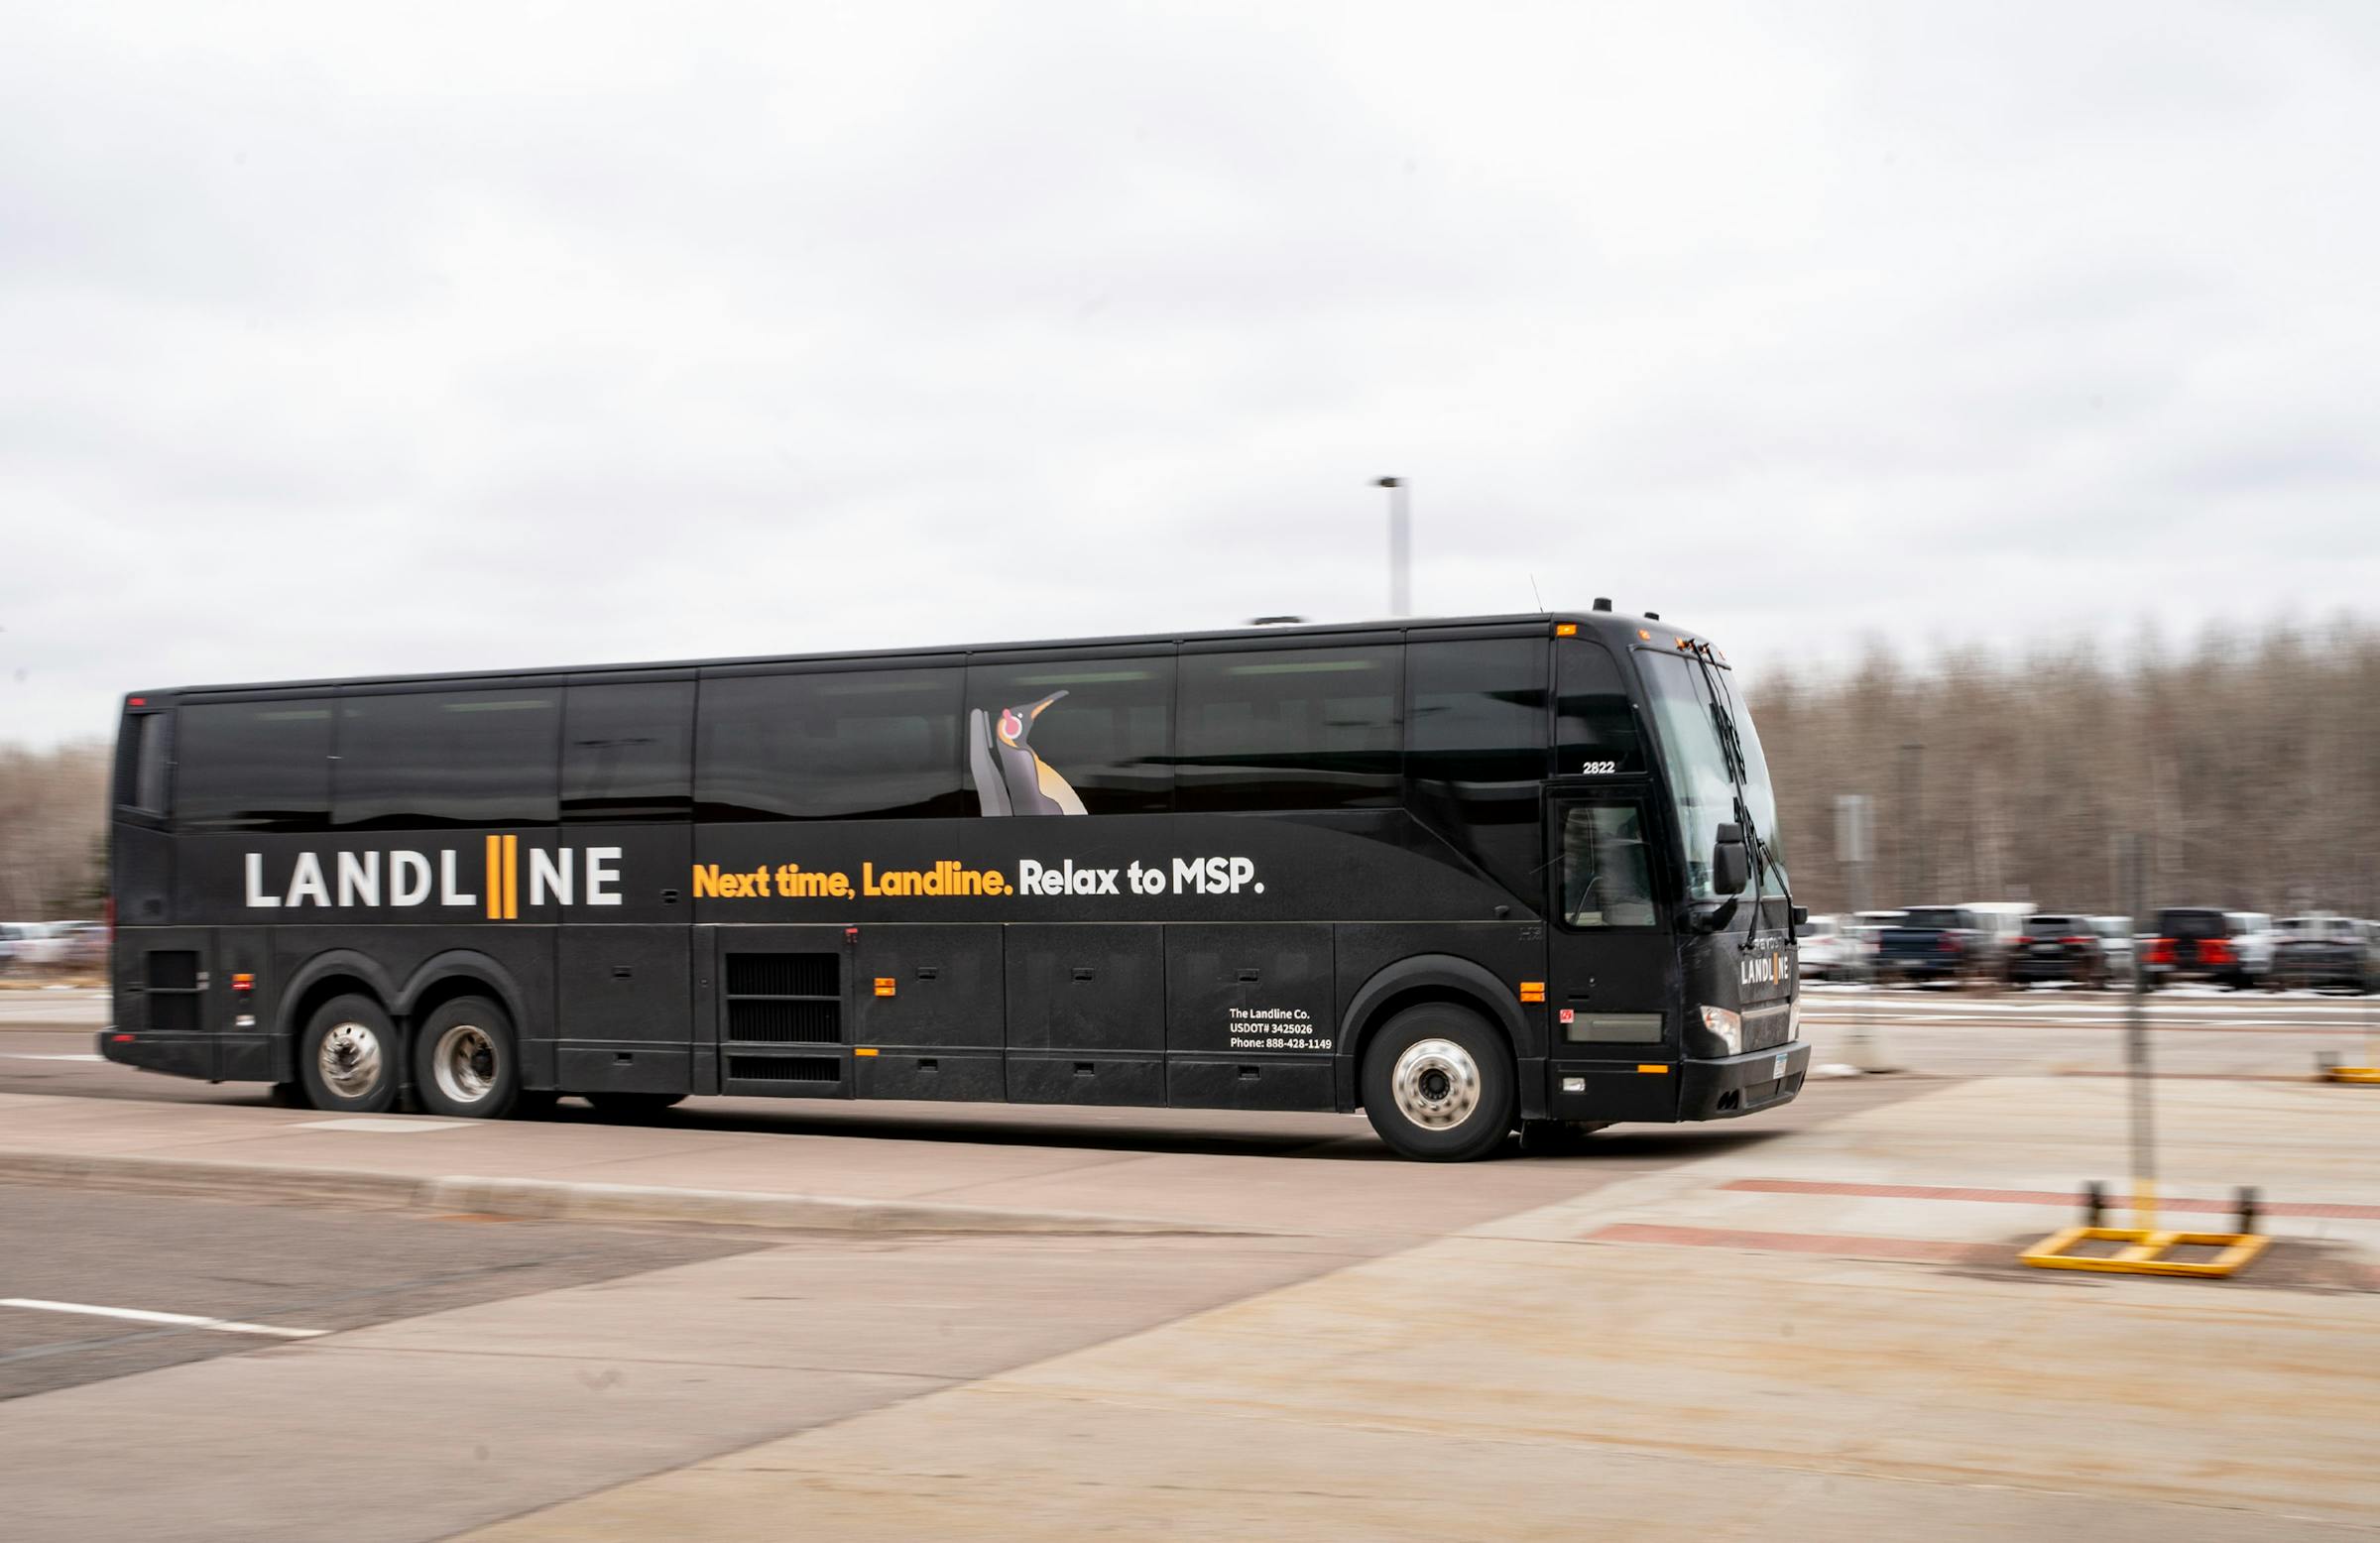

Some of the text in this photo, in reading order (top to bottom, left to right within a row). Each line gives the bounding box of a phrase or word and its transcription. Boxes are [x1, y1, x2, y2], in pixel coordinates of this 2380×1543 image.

[1583, 761, 1615, 774] 2822
[245, 835, 623, 919] LANDLINE
[692, 857, 1264, 899] Next time, Landline. Relax to MSP.
[1740, 951, 1789, 985] LANDLINE
[1230, 1009, 1310, 1019] The Landline Co.
[1230, 1022, 1313, 1034] USDOT# 3425026
[1231, 1037, 1332, 1049] Phone: 888-428-1149
